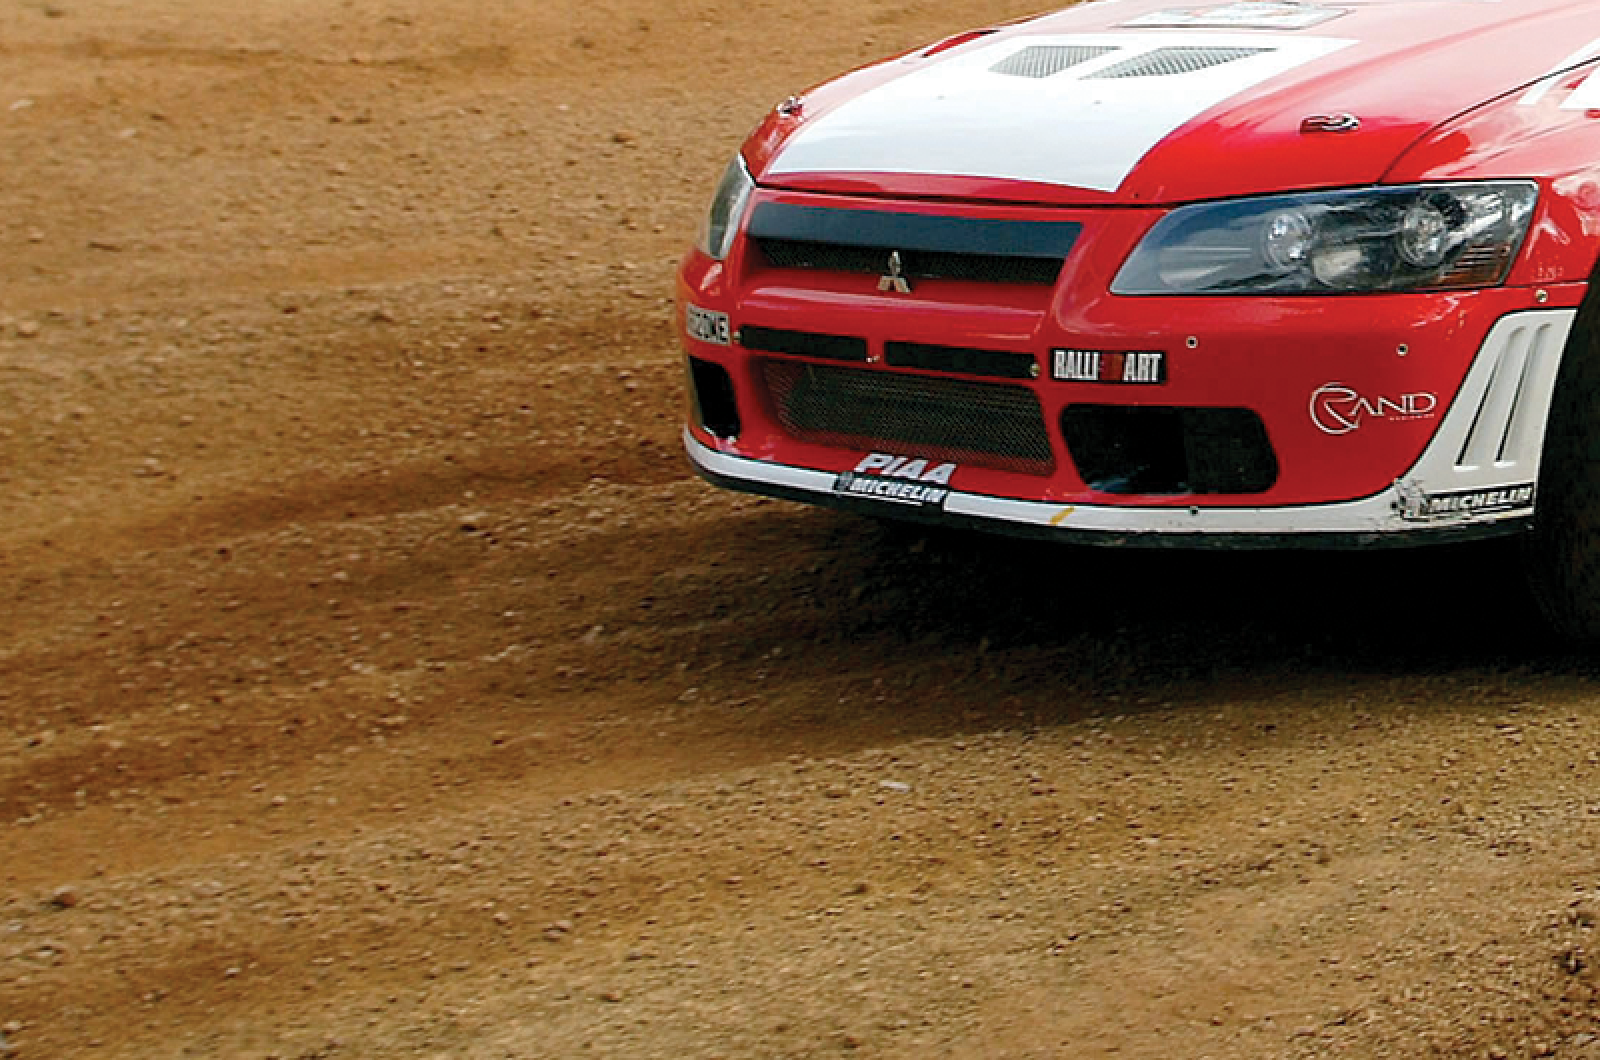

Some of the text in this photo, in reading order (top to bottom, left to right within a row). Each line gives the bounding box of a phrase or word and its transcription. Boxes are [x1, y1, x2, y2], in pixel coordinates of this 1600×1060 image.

[853, 453, 957, 484] PIAA
[850, 478, 948, 502] MICHELIN
[1431, 487, 1531, 512] MICHELIN
